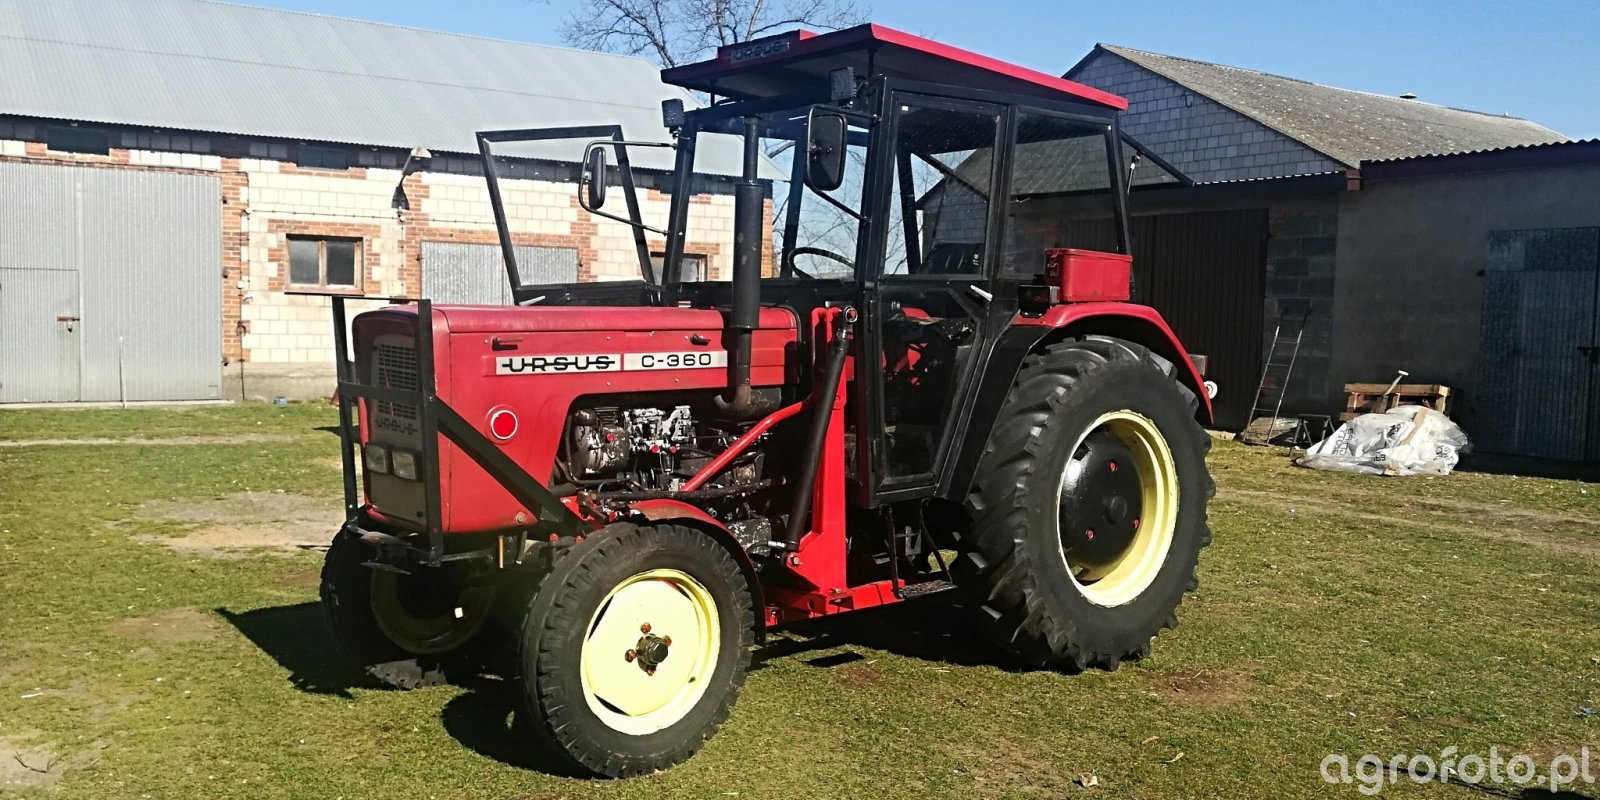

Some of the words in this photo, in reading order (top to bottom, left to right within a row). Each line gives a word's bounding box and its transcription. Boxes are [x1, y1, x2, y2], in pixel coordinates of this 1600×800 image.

[502, 355, 616, 373] URSUS
[641, 353, 712, 368] C-360
[374, 417, 419, 436] URSUS
